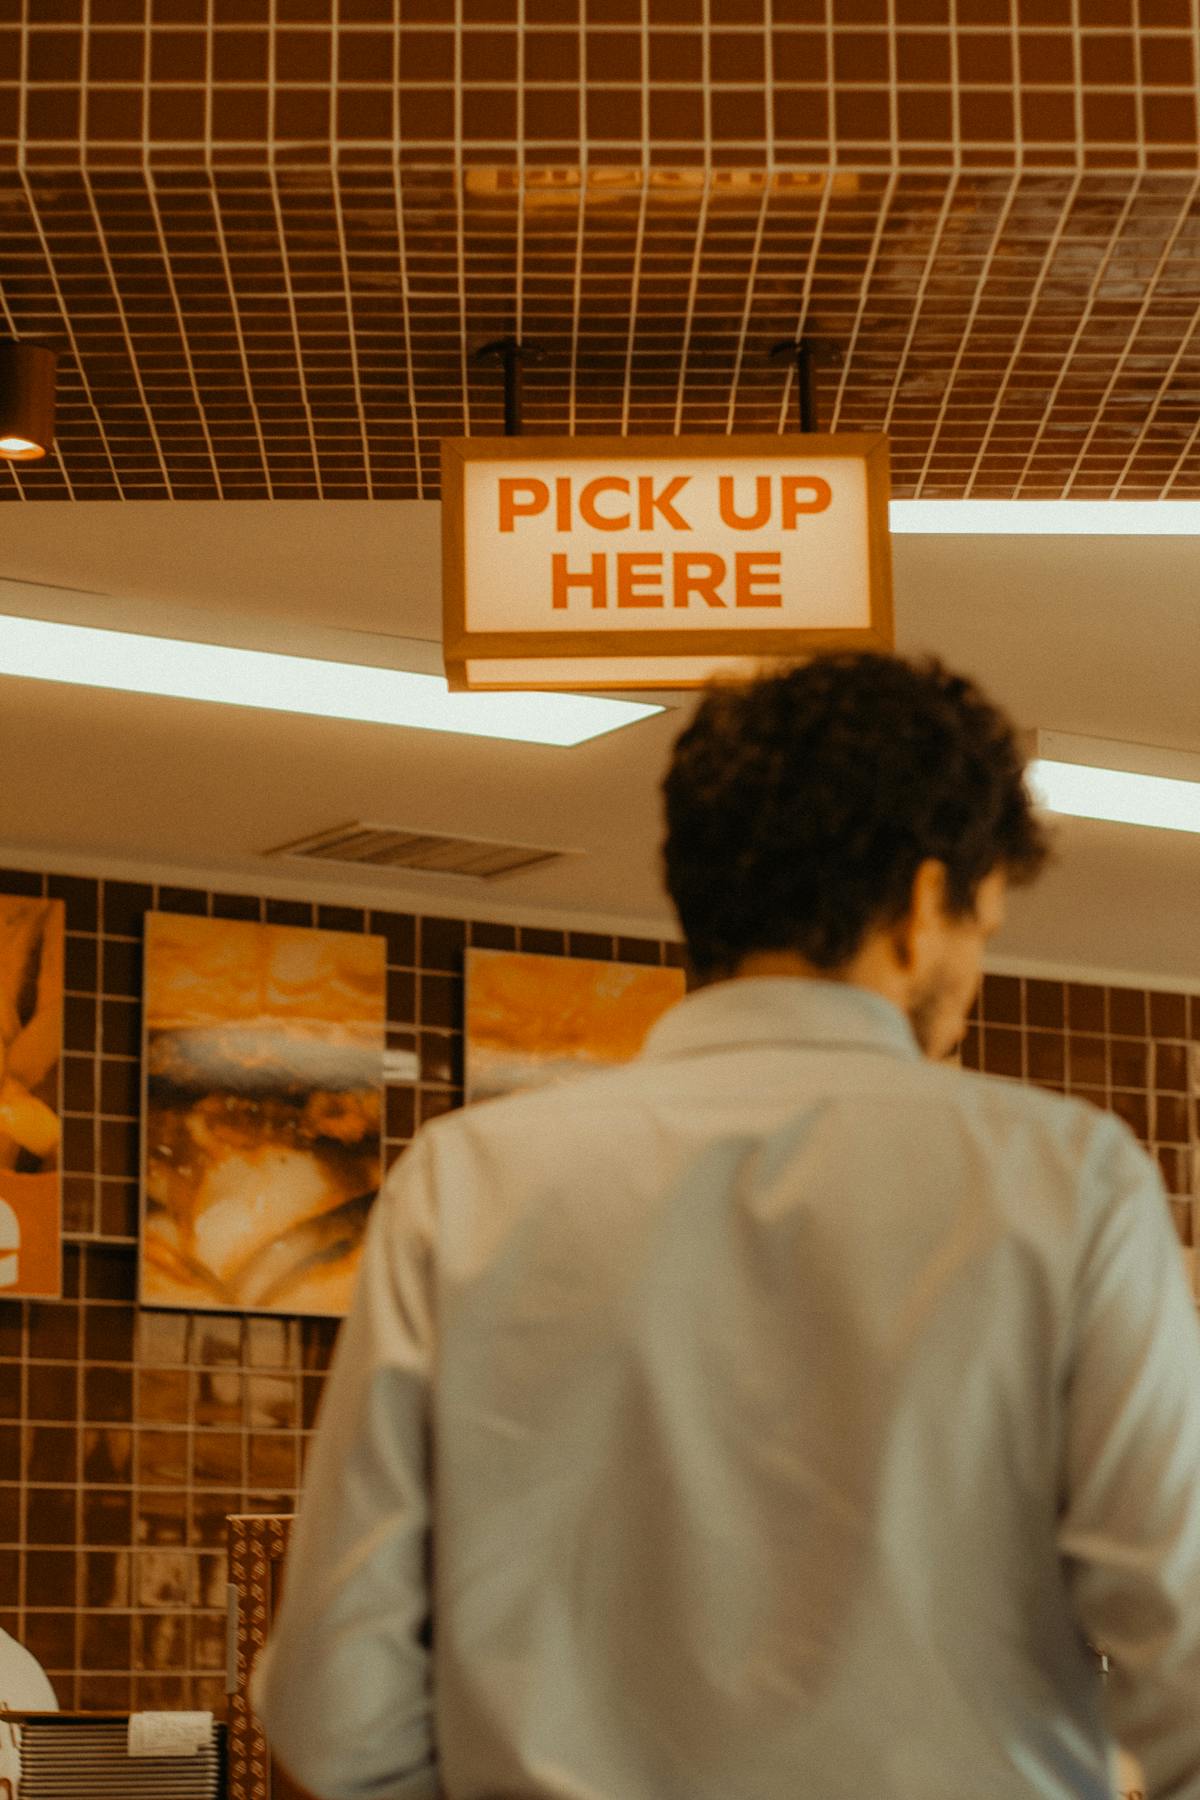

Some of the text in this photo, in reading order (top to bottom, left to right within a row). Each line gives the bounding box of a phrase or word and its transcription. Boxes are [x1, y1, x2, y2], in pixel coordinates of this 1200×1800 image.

[498, 475, 833, 532] PICK UP
[551, 551, 783, 610] HERE
